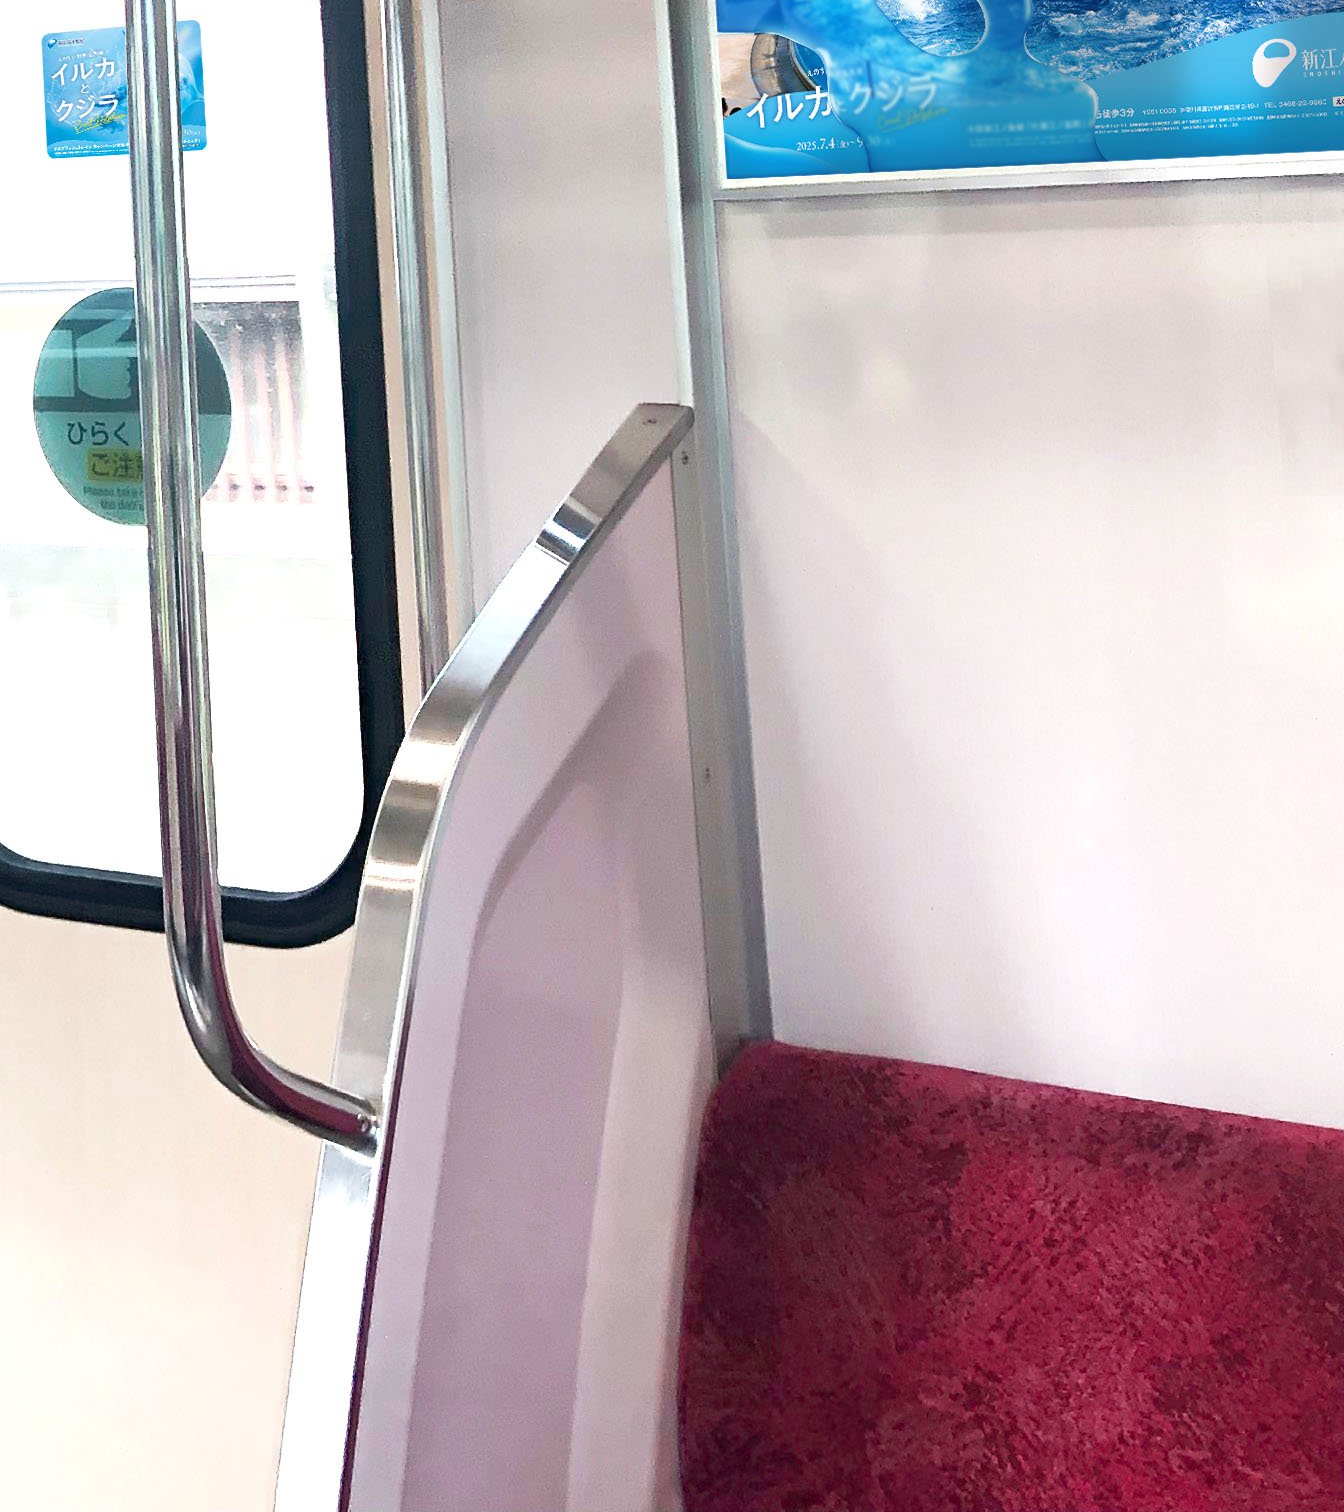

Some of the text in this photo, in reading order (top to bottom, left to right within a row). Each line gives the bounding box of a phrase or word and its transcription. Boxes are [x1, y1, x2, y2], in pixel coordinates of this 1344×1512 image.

[51, 58, 115, 86] イルカ
[80, 84, 89, 94] と
[56, 94, 119, 122] クジラ
[67, 421, 130, 446] ひらく
